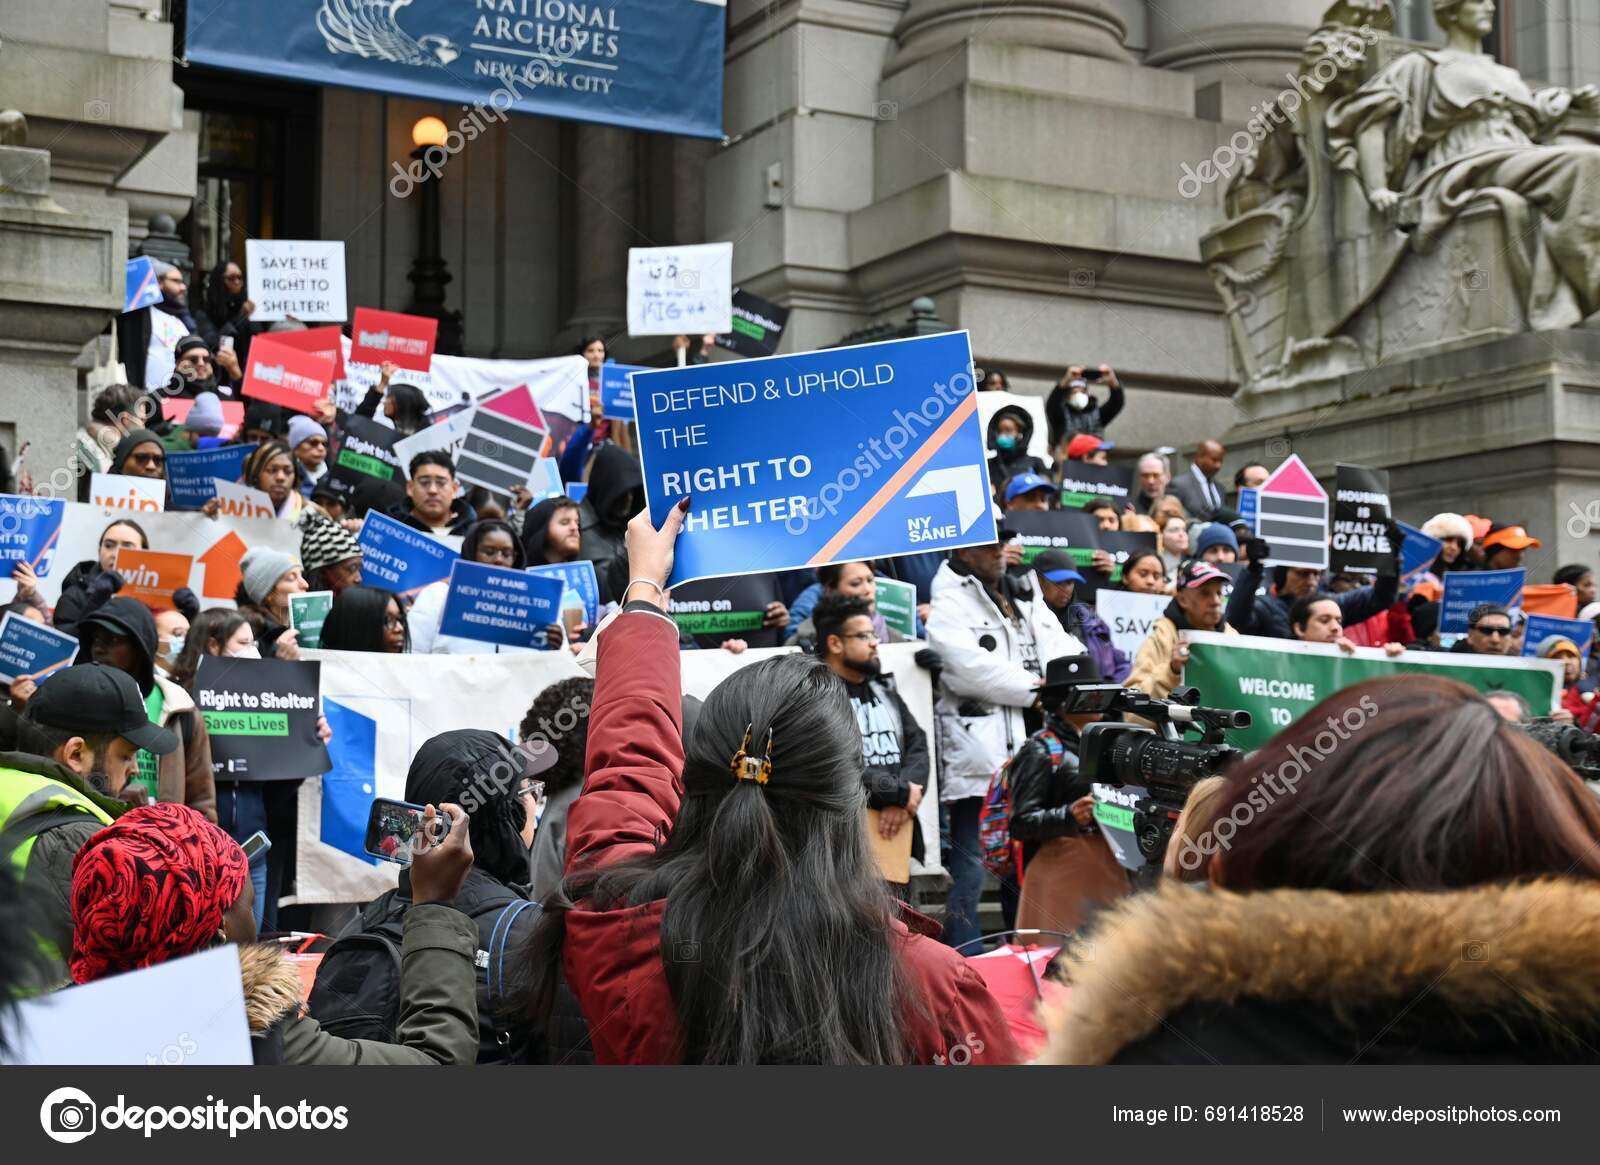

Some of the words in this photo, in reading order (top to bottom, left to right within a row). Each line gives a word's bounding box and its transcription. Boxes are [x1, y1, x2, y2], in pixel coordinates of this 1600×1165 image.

[473, 14, 618, 58] ARCHIVES
[474, 59, 517, 79] NEW
[571, 73, 613, 94] CITY
[260, 257, 298, 270] SAVE
[301, 257, 328, 270] THE
[262, 279, 305, 291] RIGHT
[310, 279, 330, 291] TO
[263, 300, 331, 313] SHELTER!
[651, 380, 757, 414] DEFEND
[763, 378, 782, 400] &
[785, 364, 895, 397] UPHOLD
[655, 424, 708, 449] THE
[662, 462, 760, 496] RIGHT
[768, 455, 812, 480] TO
[678, 496, 809, 534] HELTER
[907, 516, 932, 531] NY
[368, 518, 405, 540] DEFEND
[908, 525, 958, 542] SANE
[14, 534, 29, 545] TO
[1332, 533, 1392, 553] CARE
[392, 557, 408, 572] TO
[117, 563, 160, 588] win
[456, 585, 481, 598] NEW
[481, 589, 508, 601] YORK
[508, 592, 551, 608] SHELTER
[669, 598, 710, 613] hame
[711, 600, 732, 612] on
[475, 601, 498, 612] FOR
[497, 605, 516, 616] ALL
[516, 608, 528, 618] IN
[462, 612, 490, 625] NEED
[490, 615, 537, 632] EQUALLY
[1114, 616, 1153, 635] SAV
[1238, 677, 1316, 701] WELCOME
[200, 690, 241, 711] Right
[241, 692, 259, 708] to
[260, 692, 315, 709] Shelter
[203, 714, 246, 730] Saves
[248, 716, 286, 731] Lives
[1270, 708, 1292, 725] TO
